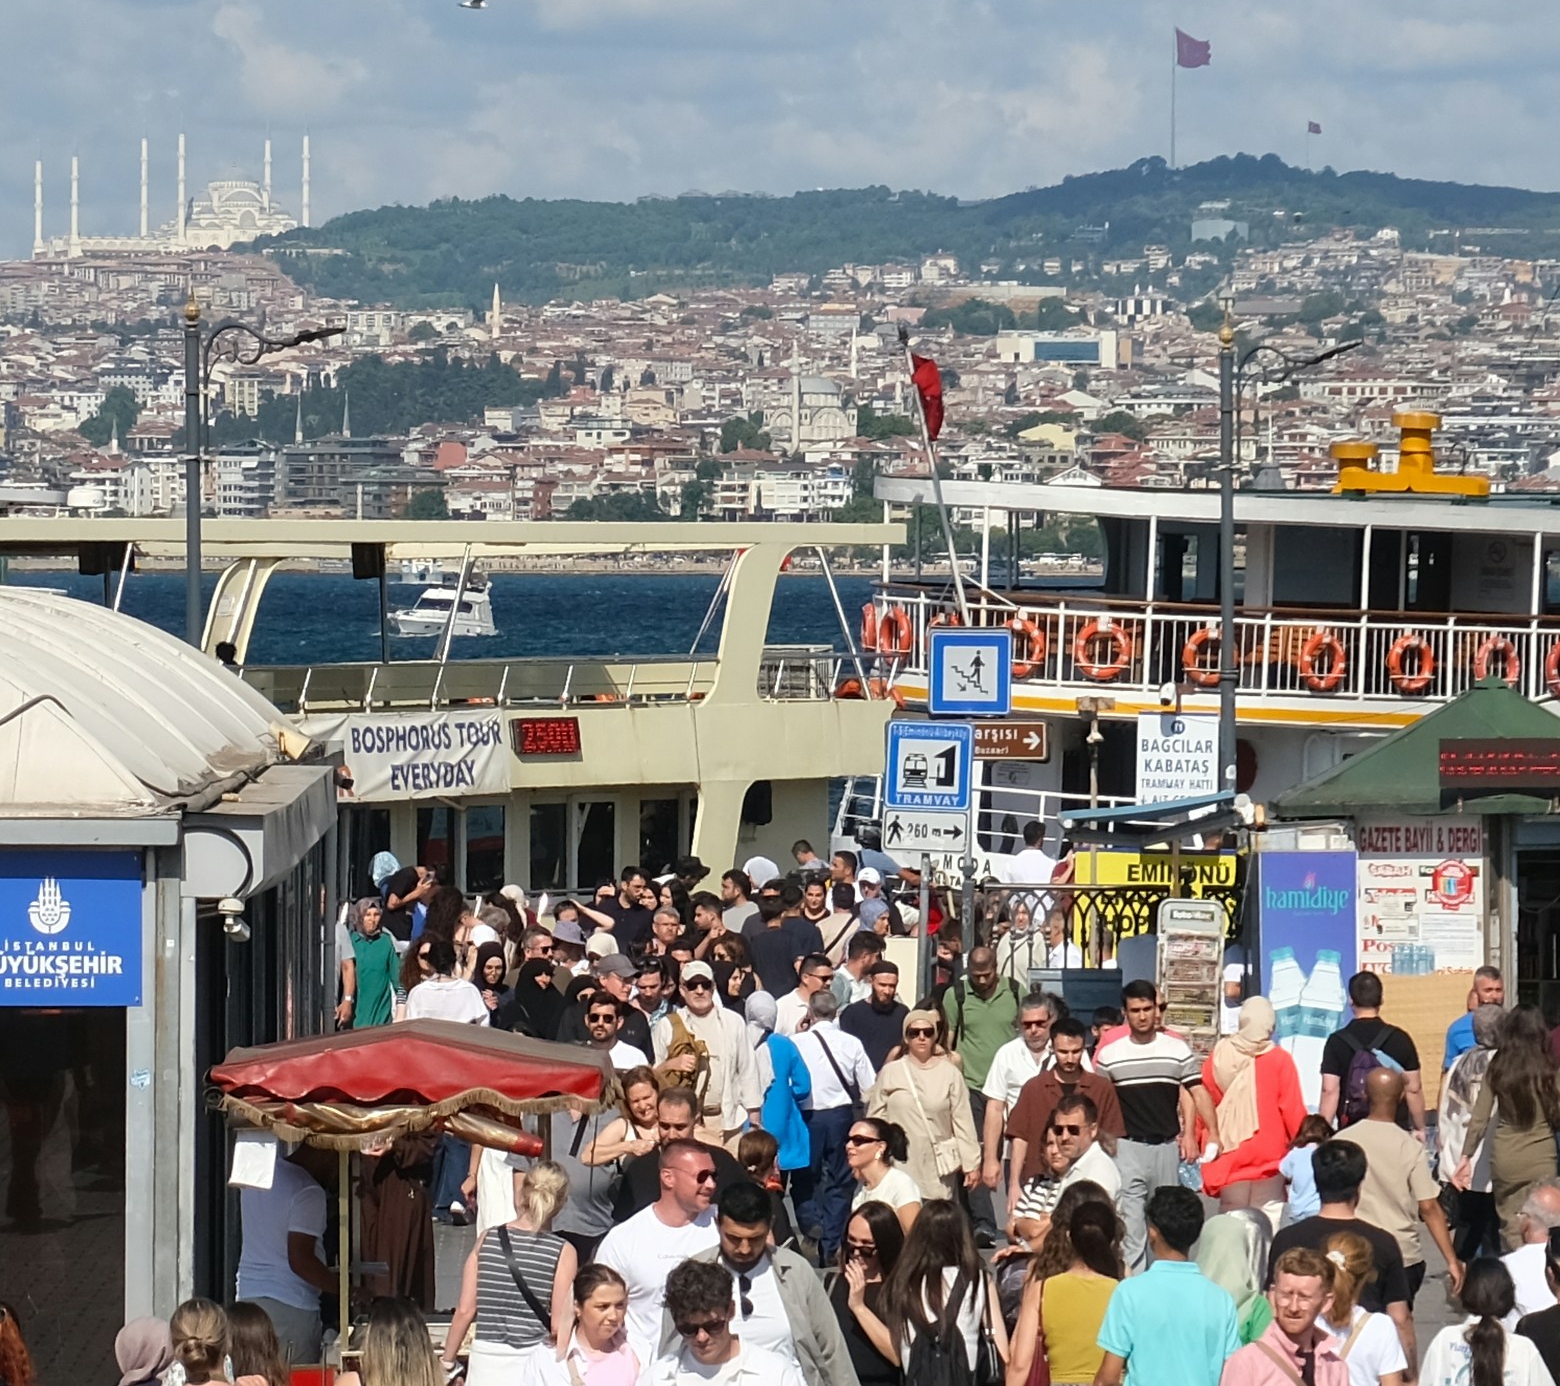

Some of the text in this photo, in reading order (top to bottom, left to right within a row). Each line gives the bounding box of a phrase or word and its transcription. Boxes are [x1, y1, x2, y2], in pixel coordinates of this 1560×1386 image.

[351, 721, 452, 754] BOSPHORUS
[454, 721, 503, 749] TOUR
[391, 760, 477, 792] EVERYDAY
[1144, 758, 1210, 777] KABATAŞ
[895, 793, 961, 807] TRAMVAY
[1359, 826, 1402, 853] GAZETE
[1437, 826, 1445, 853] &
[1266, 884, 1350, 915] hamidiye
[4, 937, 95, 952] İSTANBUL
[4, 975, 95, 989] BELEDİYESİ
